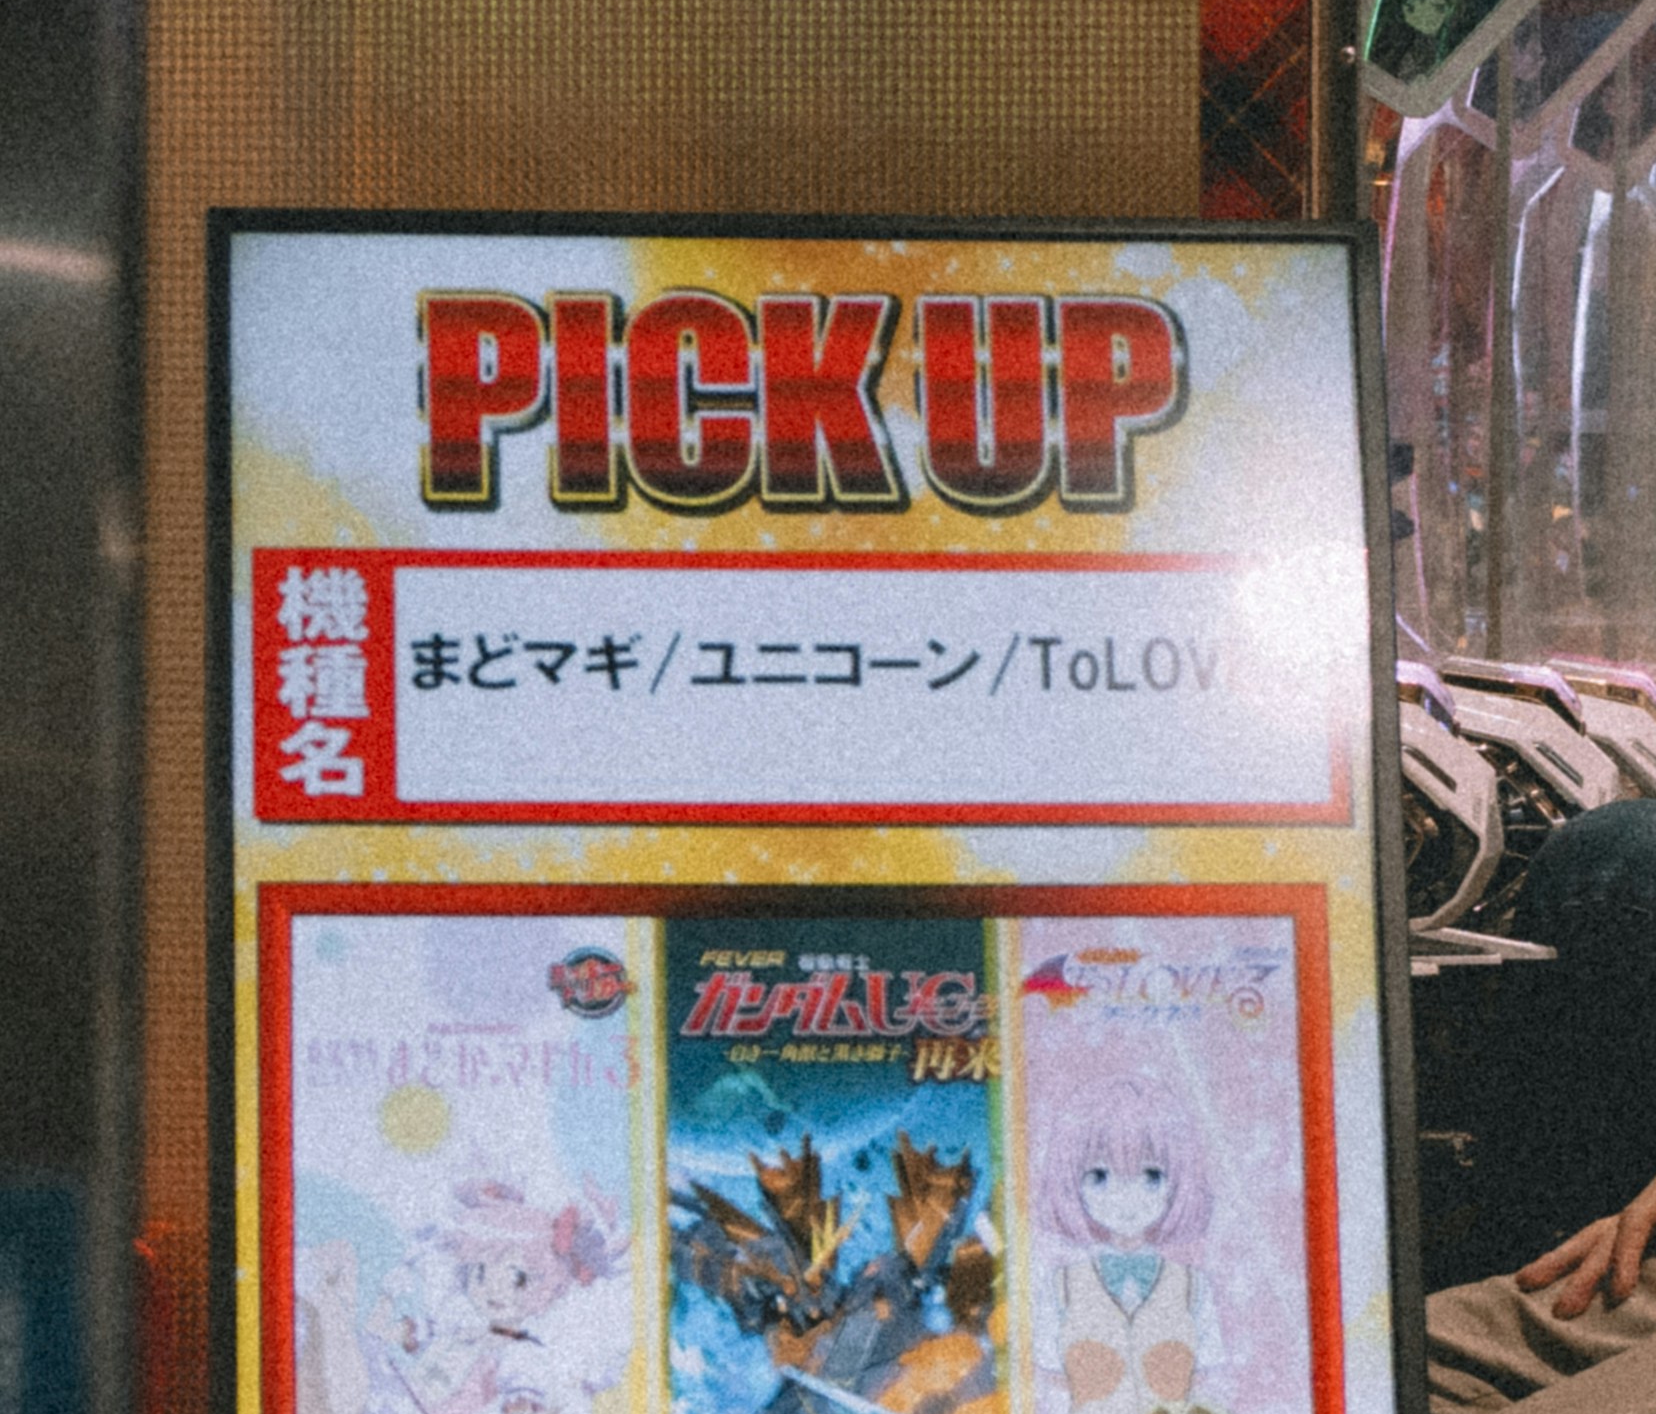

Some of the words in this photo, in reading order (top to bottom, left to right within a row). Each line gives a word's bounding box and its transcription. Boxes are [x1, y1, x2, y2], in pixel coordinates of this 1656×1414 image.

[420, 289, 902, 507] PICK
[916, 289, 1182, 507] UP
[277, 566, 371, 797] 機種名
